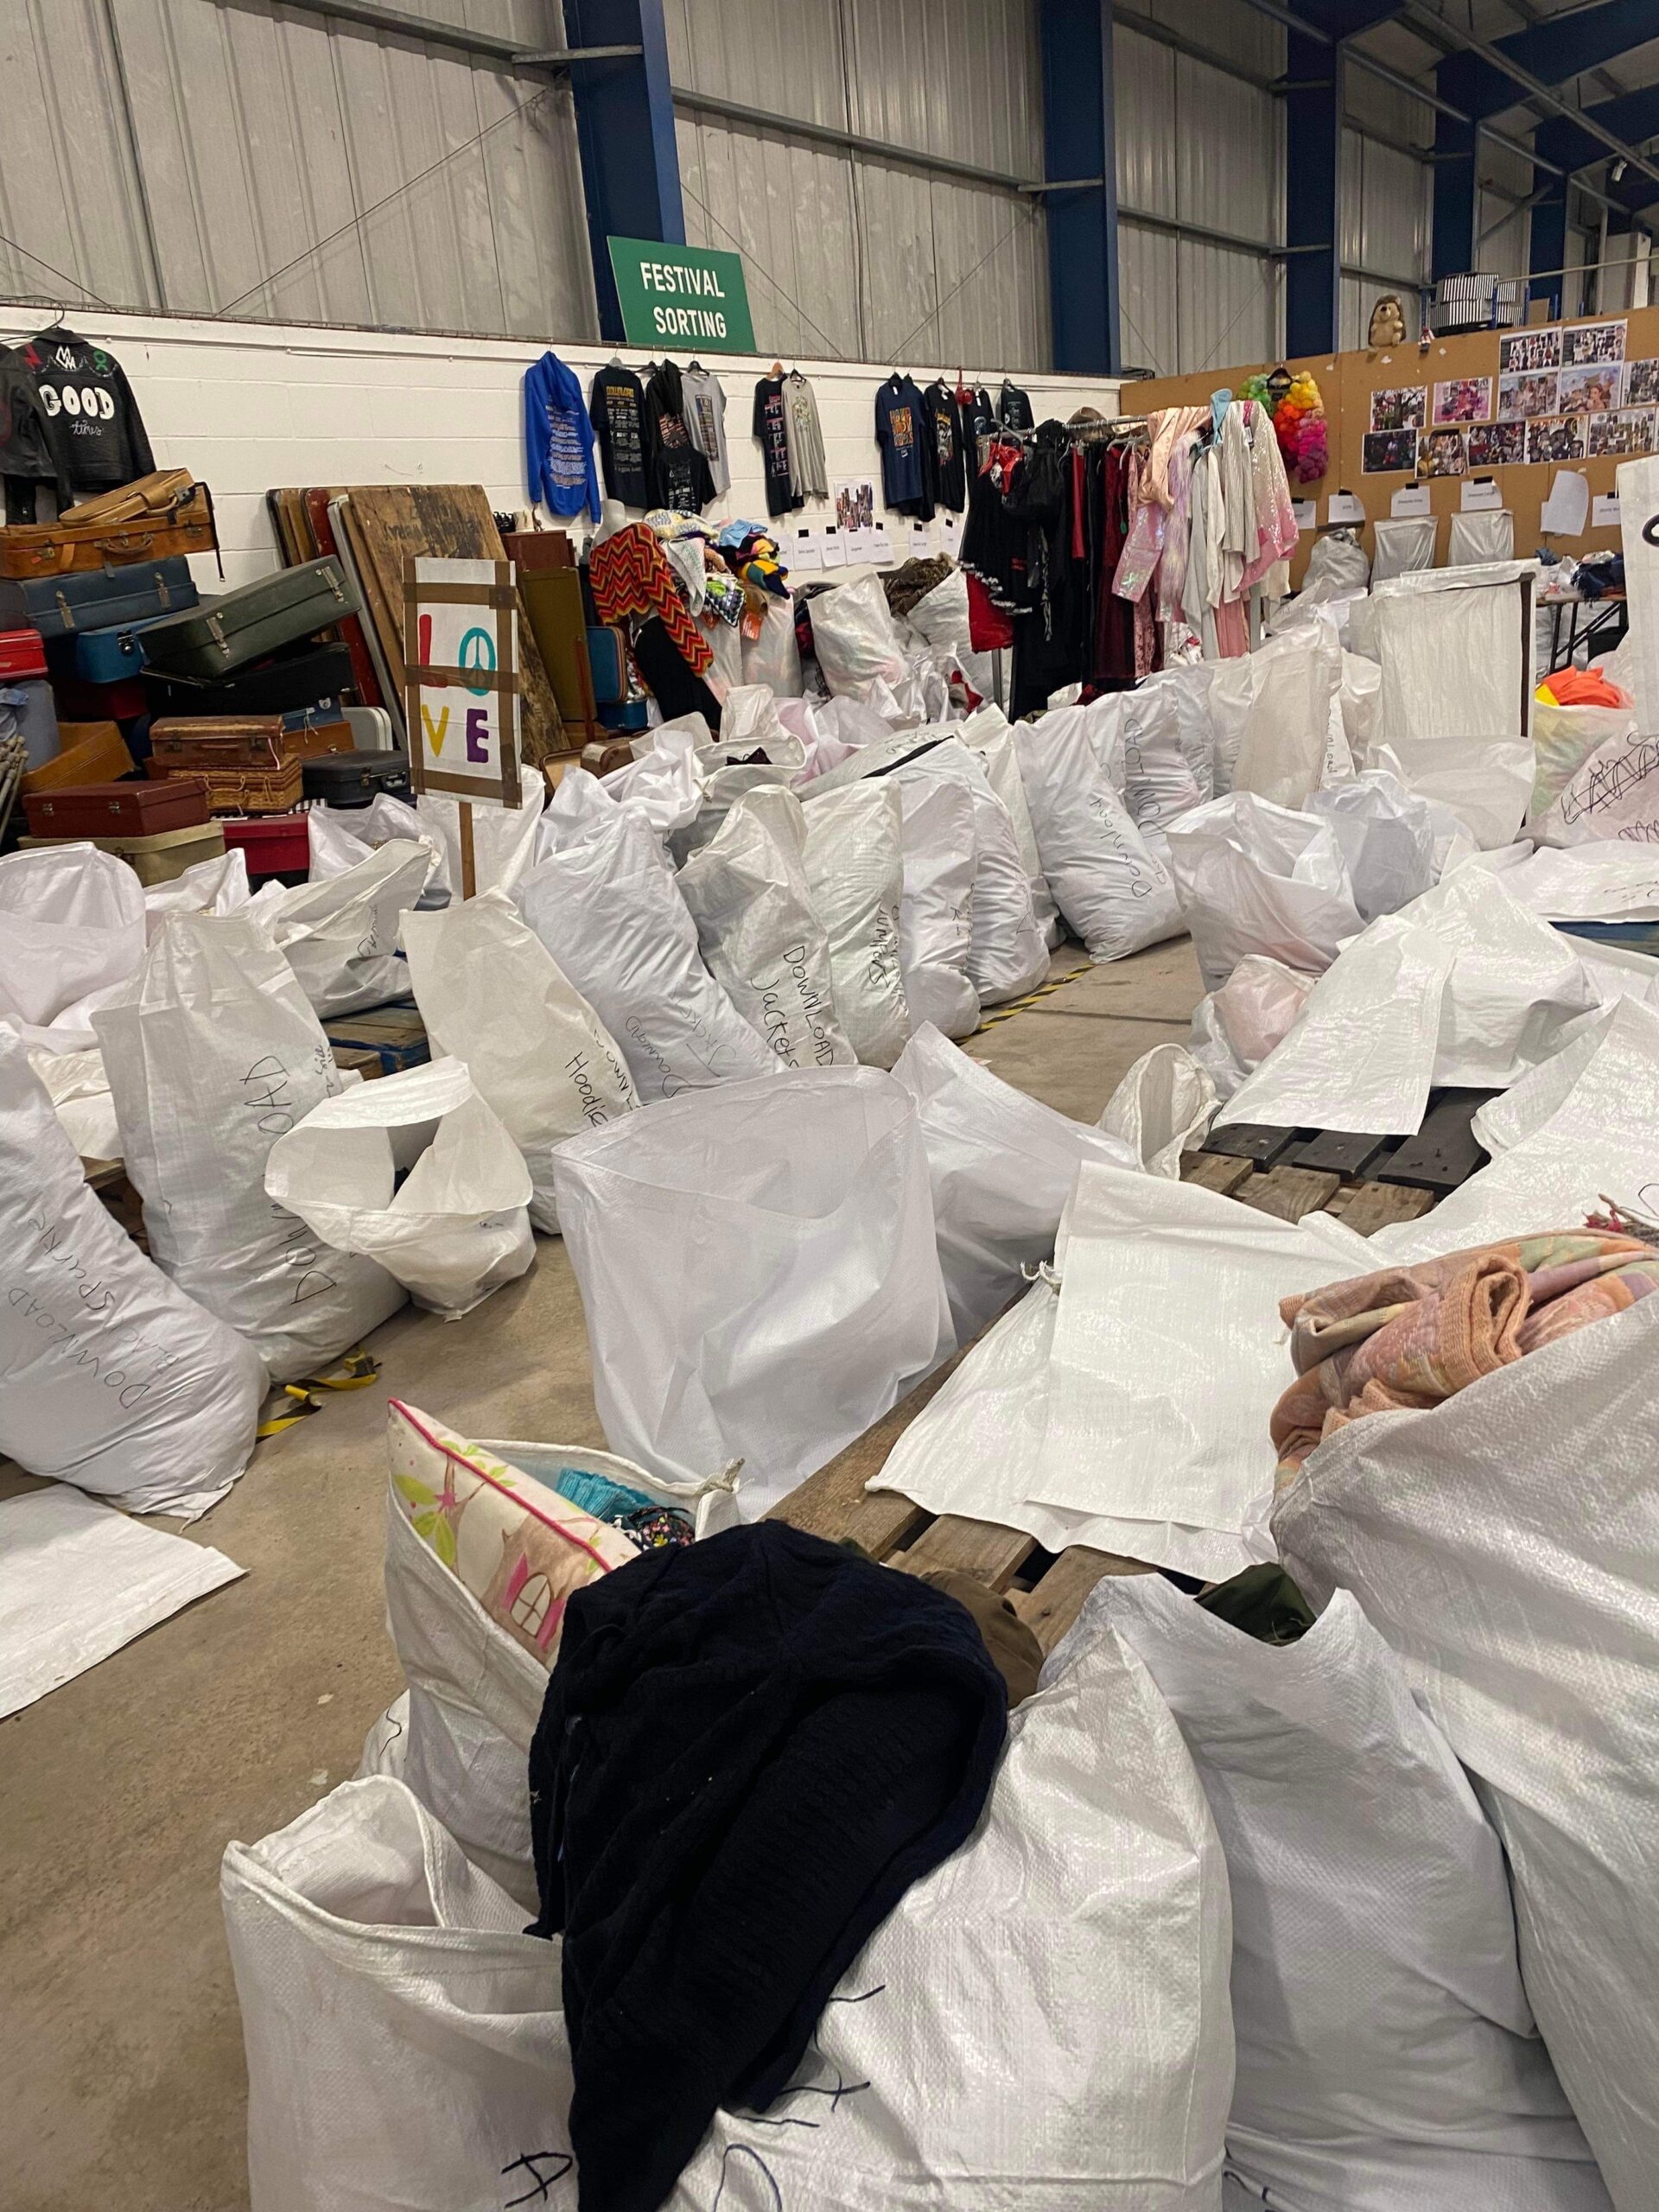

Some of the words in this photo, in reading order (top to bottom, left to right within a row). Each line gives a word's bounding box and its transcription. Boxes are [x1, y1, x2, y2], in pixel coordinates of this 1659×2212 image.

[639, 262, 726, 298] FESTIVAL
[653, 306, 727, 339] SORTING
[38, 384, 115, 420] GOOD
[783, 944, 835, 1066] DOWNLOAD
[8, 1287, 151, 1409] DOWNLOAD
